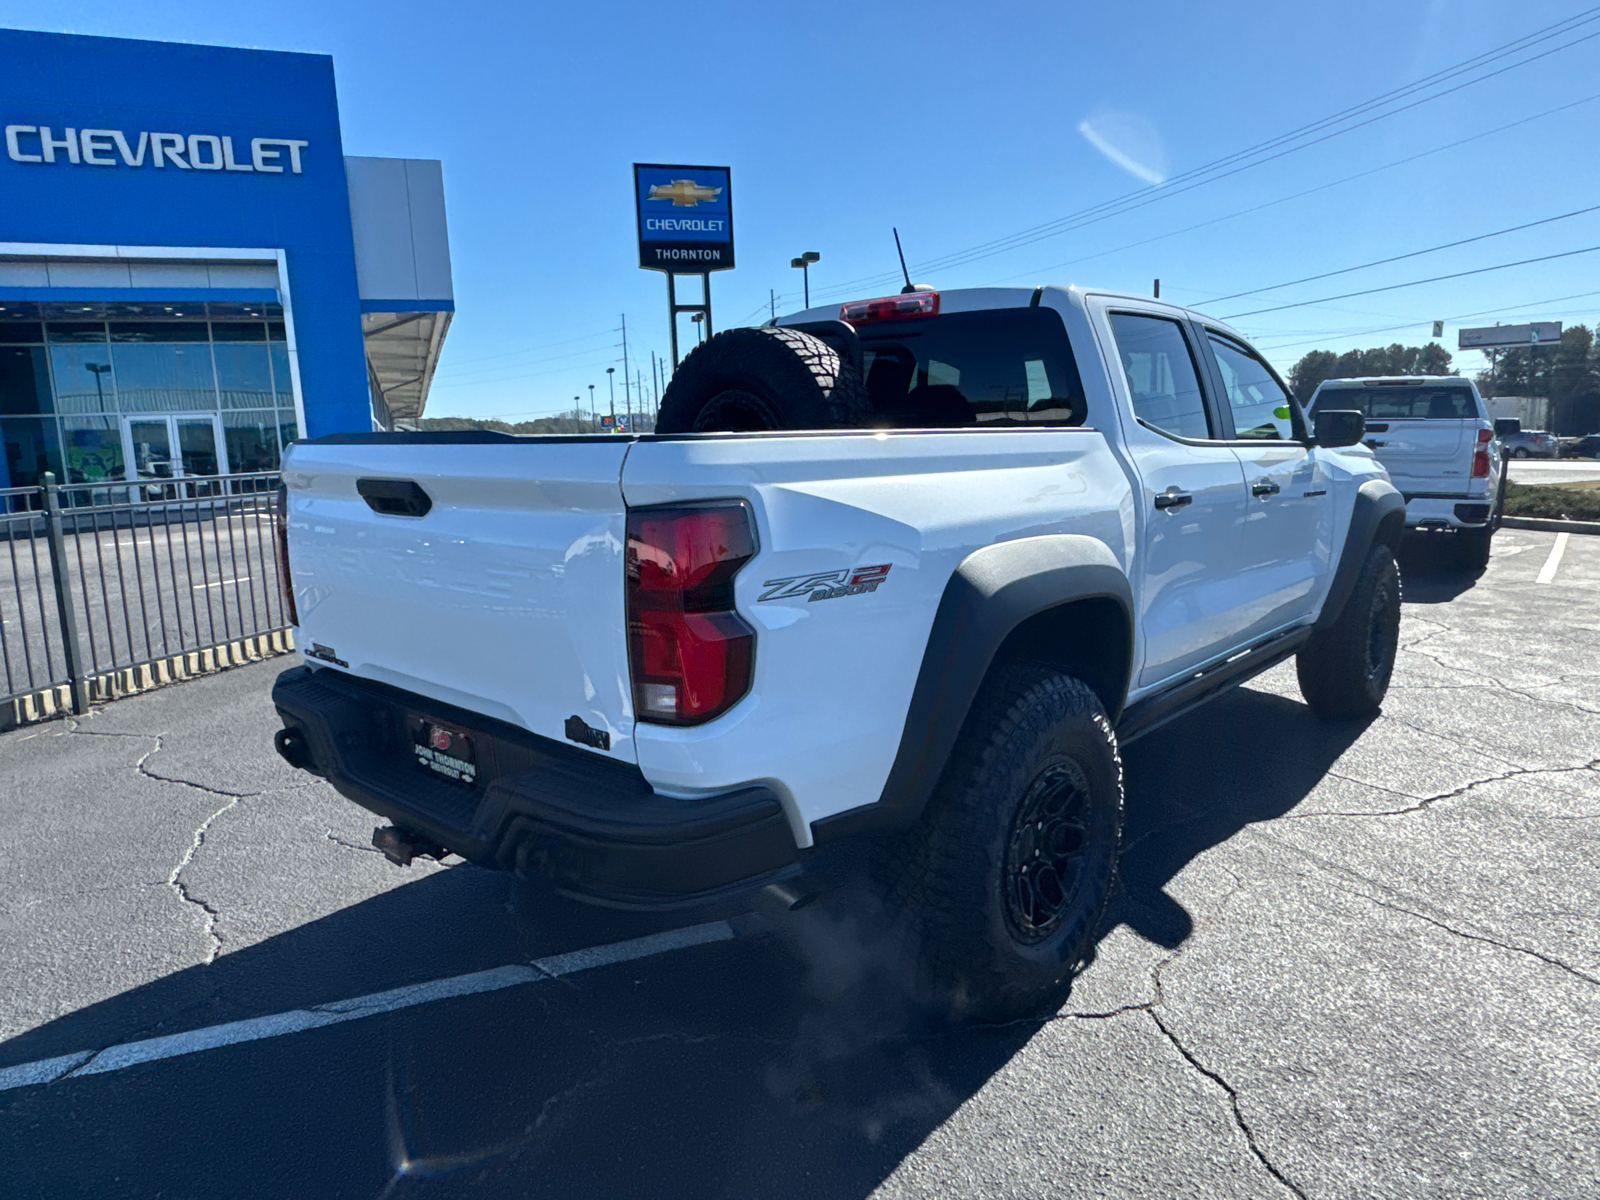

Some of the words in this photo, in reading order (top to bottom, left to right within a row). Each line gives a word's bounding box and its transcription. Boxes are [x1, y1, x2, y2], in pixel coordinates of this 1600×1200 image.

[5, 124, 309, 174] CHEVROLET
[646, 218, 725, 232] CHEVROLET
[655, 248, 721, 260] THORNTON
[757, 562, 893, 602] ZR2
[807, 580, 881, 602] BISON
[414, 743, 434, 761] JOHN
[434, 751, 476, 777] THORNTON
